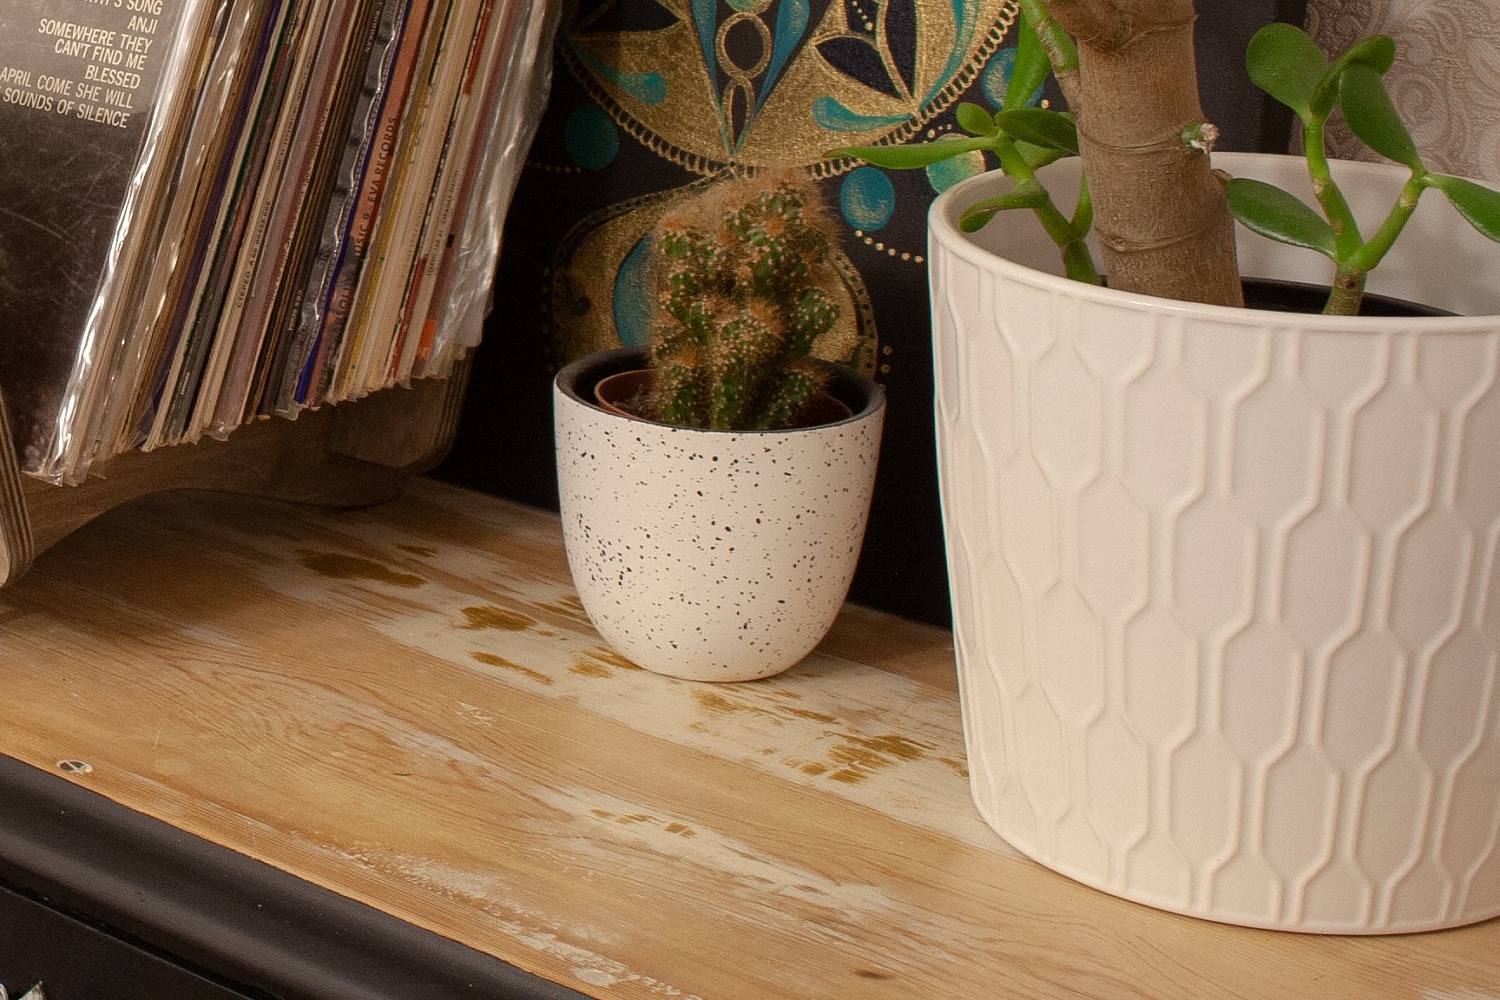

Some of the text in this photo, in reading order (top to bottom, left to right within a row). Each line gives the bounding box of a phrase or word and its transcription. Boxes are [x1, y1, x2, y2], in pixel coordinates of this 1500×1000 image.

[38, 18, 153, 54] SOMEWHERE THEY
[127, 15, 158, 34] ANJI
[54, 39, 148, 71] CAN'T FIND ME
[37, 74, 72, 97] COME
[75, 82, 101, 102] SHE
[104, 91, 133, 109] WILL
[85, 65, 141, 89] BLESSED
[3, 87, 53, 113] SOUNDS
[57, 98, 74, 115] OF
[76, 103, 131, 129] SILENCE
[366, 181, 379, 208] EVA
[376, 117, 397, 176] RECORDS
